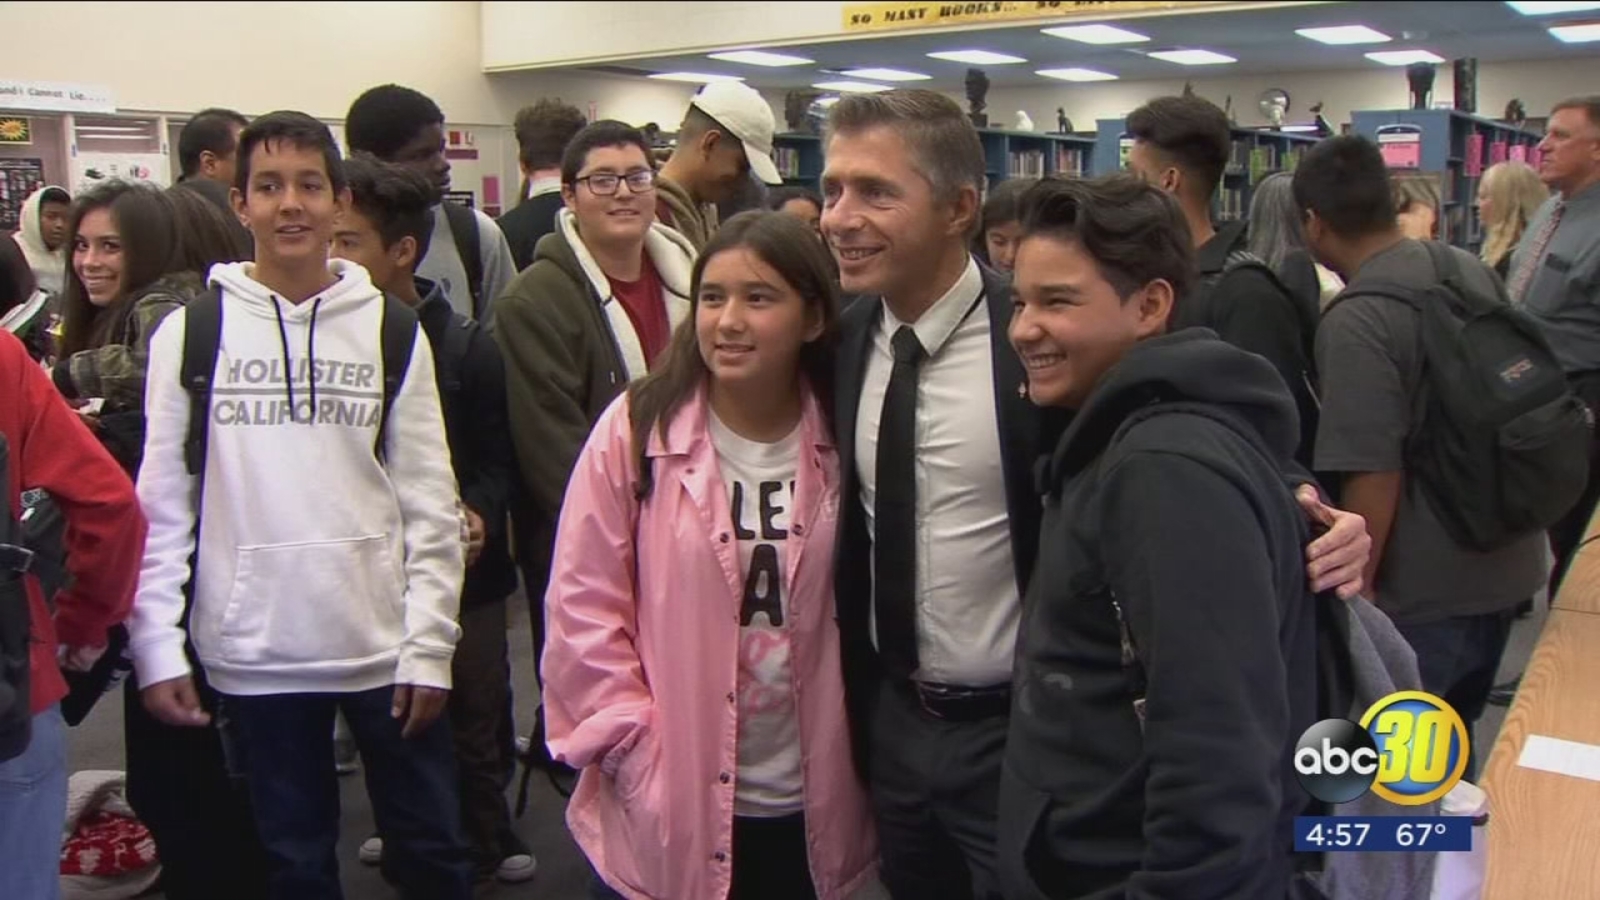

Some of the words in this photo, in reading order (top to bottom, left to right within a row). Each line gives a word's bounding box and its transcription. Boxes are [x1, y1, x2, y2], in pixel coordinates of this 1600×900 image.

[850, 13, 872, 25] SO
[28, 87, 63, 98] Cannot
[227, 358, 375, 388] HOLLISTER
[213, 399, 382, 427] CALIFORNIA
[731, 480, 796, 541] LE
